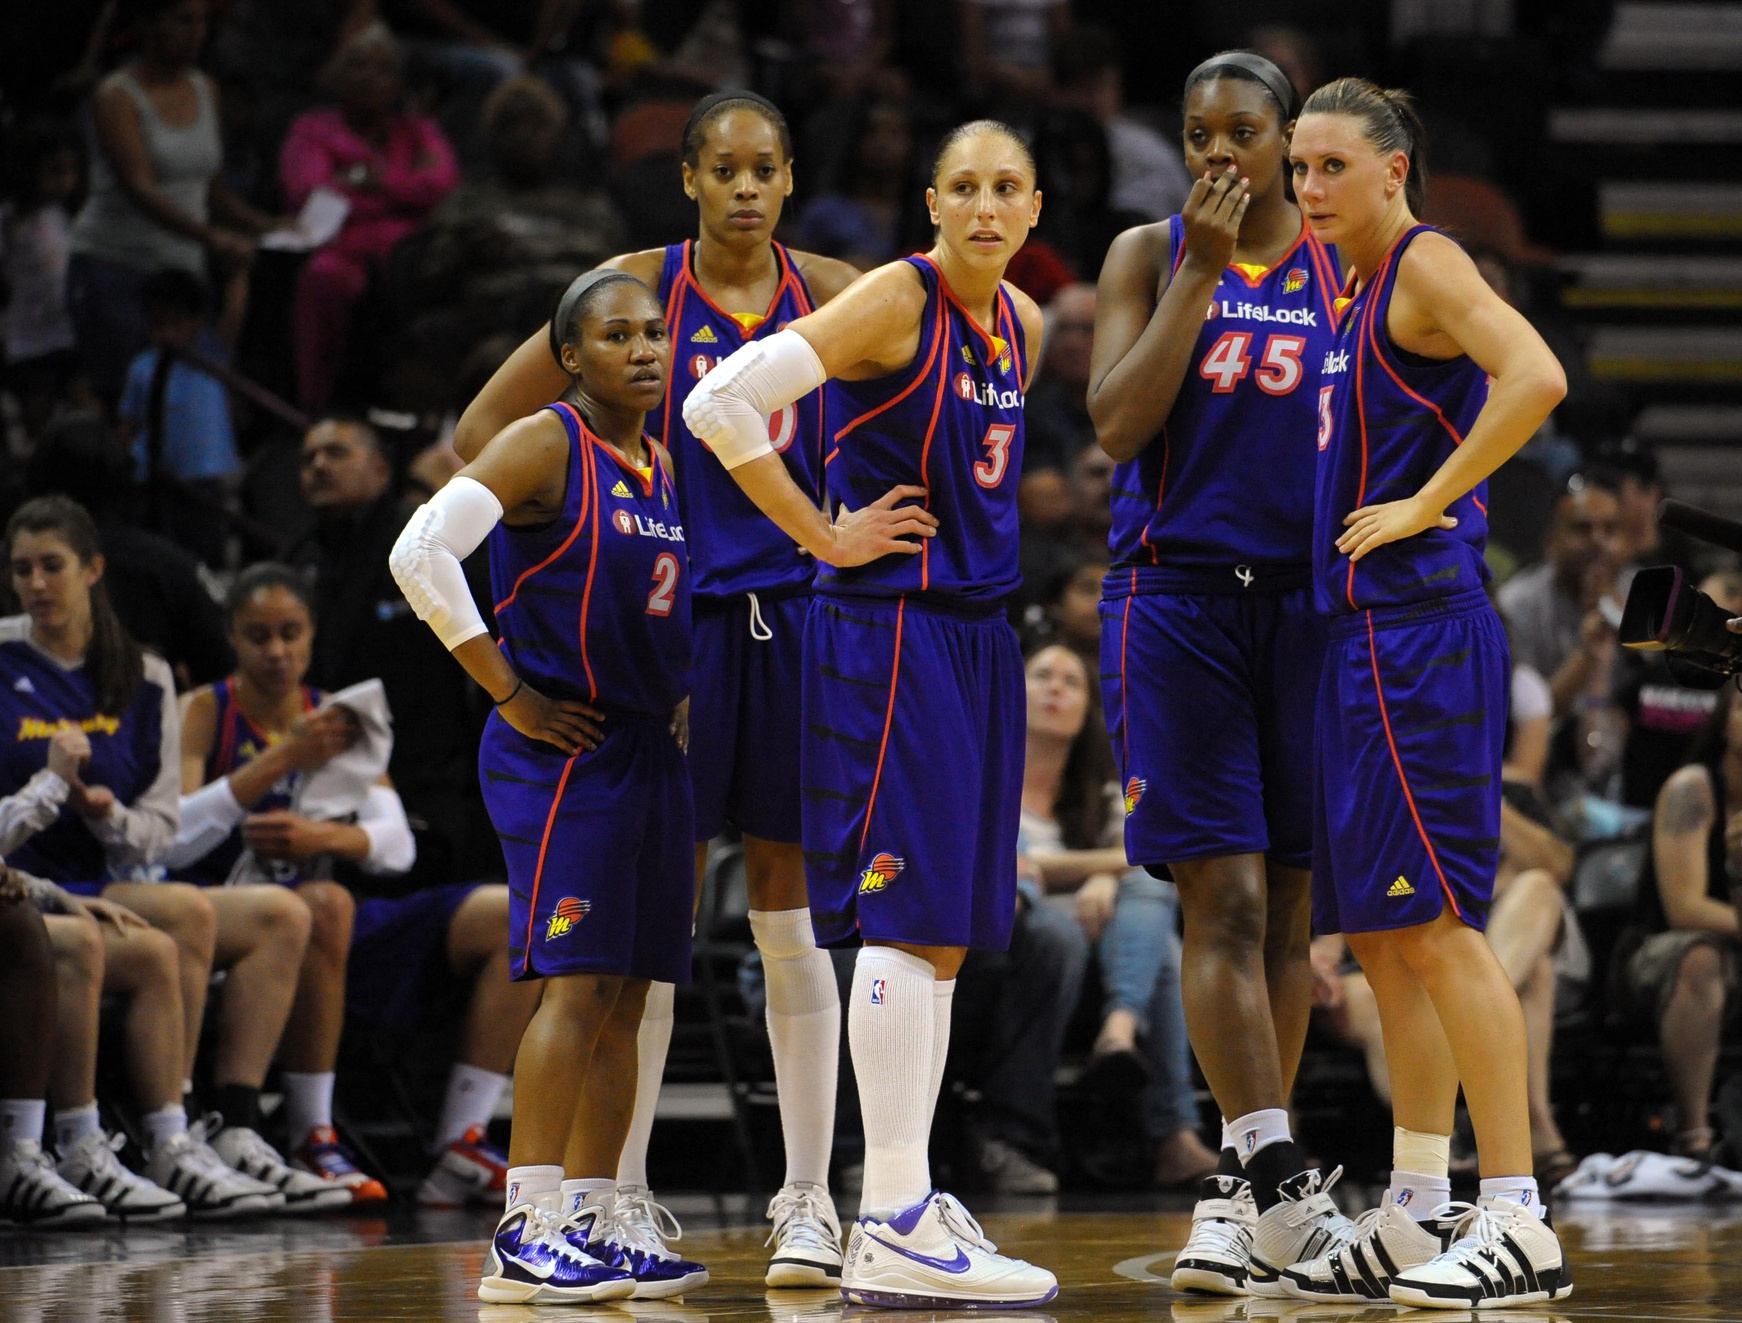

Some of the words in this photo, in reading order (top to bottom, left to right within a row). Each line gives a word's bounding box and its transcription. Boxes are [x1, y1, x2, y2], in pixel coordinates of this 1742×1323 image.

[1222, 301, 1317, 327] LifeLock
[1199, 331, 1306, 396] 45
[973, 423, 1016, 489] 3
[645, 552, 680, 617] 2
[1387, 887, 1415, 896] adidas
